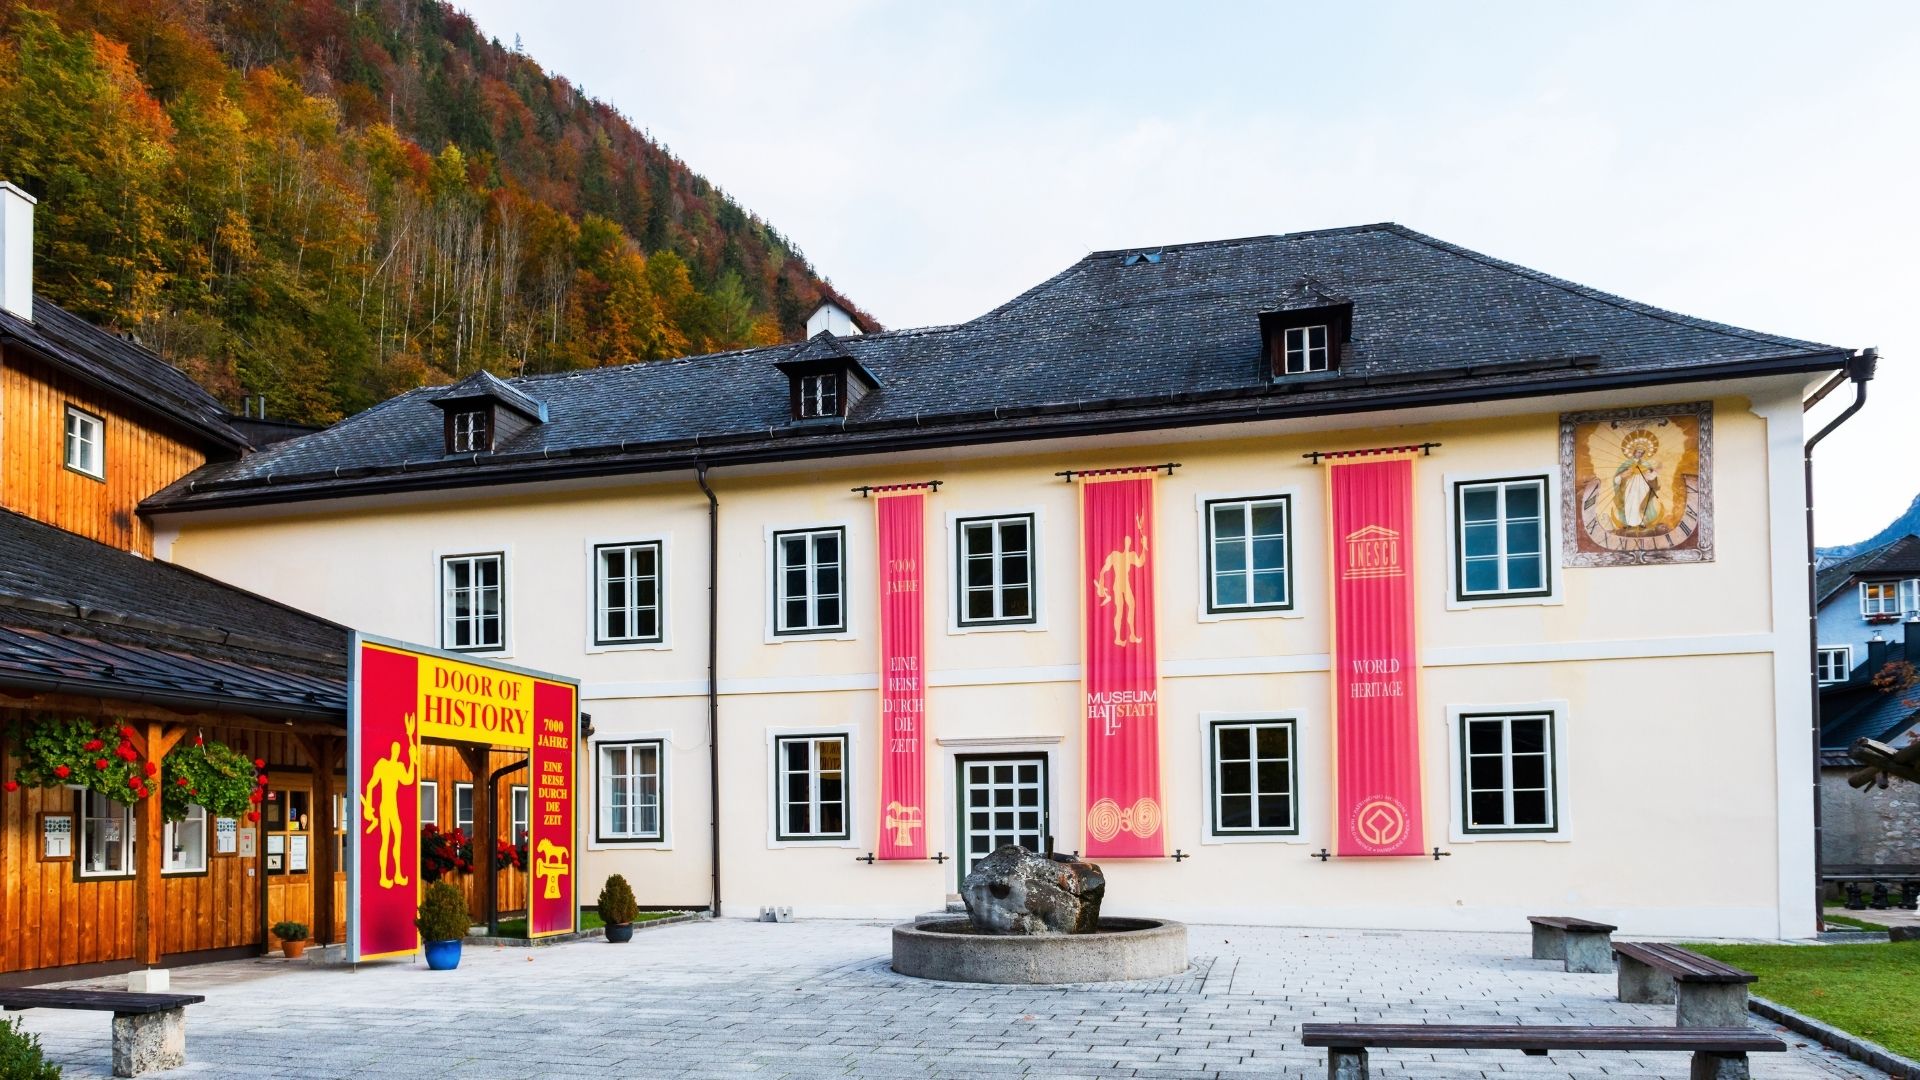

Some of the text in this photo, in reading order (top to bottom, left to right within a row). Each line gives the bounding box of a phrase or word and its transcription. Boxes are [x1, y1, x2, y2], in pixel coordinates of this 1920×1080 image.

[1349, 541, 1397, 567] UNESCO
[888, 558, 916, 573] 7000
[886, 580, 919, 595] JAHRE
[890, 656, 918, 671] EINE
[1352, 658, 1400, 675] WORLD
[434, 667, 522, 701] DOOR OF
[889, 677, 920, 691] REISE
[1350, 681, 1403, 698] HERITAGE
[1087, 690, 1157, 704] MUSEUM
[883, 698, 924, 713] DURCH
[424, 694, 530, 735] HISTORY
[543, 718, 564, 733] 7000
[894, 717, 915, 732] DIE
[537, 734, 568, 749] JAHRE
[891, 738, 918, 753] ZEIT
[543, 761, 563, 773] EINE
[541, 774, 564, 786] REISE
[538, 787, 568, 800] DURCH
[545, 801, 561, 812] DIE
[543, 814, 562, 825] ZEIT
